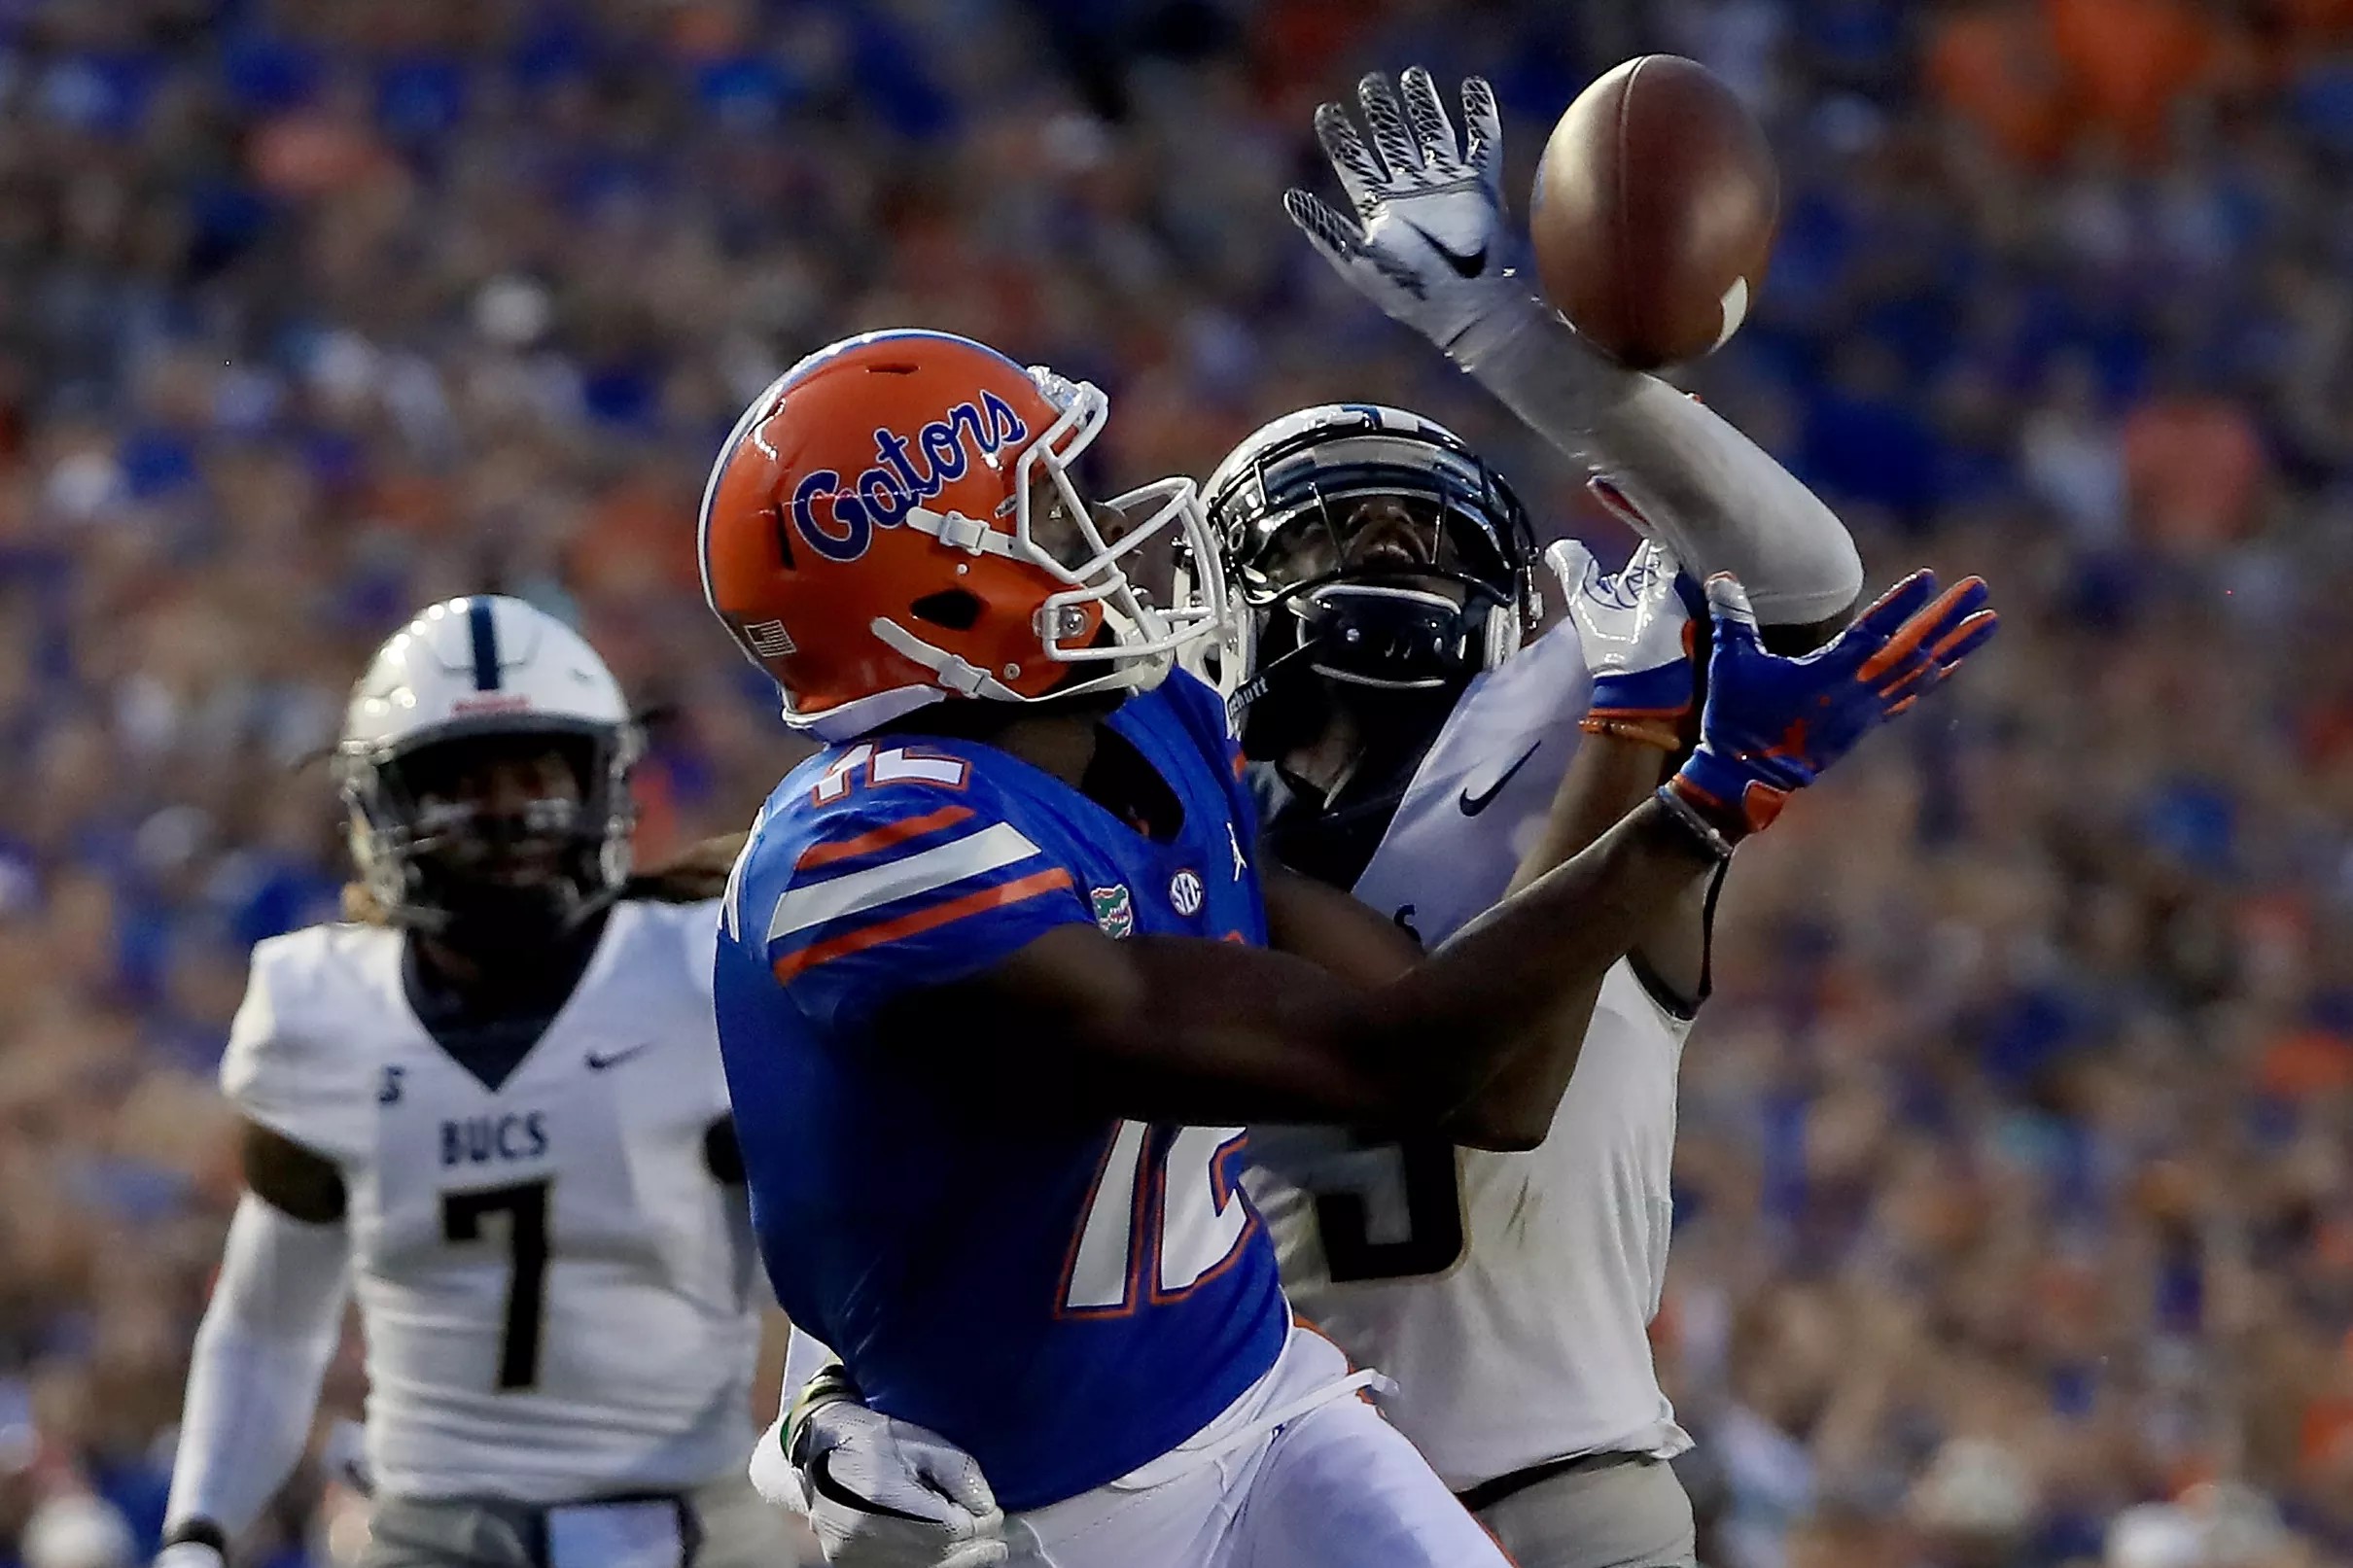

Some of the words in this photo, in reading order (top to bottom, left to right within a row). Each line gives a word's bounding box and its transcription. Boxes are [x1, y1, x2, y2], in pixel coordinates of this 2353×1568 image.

[792, 390, 1028, 562] Gators
[1171, 873, 1201, 915] SEC
[440, 1111, 549, 1167] BUCS
[440, 1176, 552, 1393] 7
